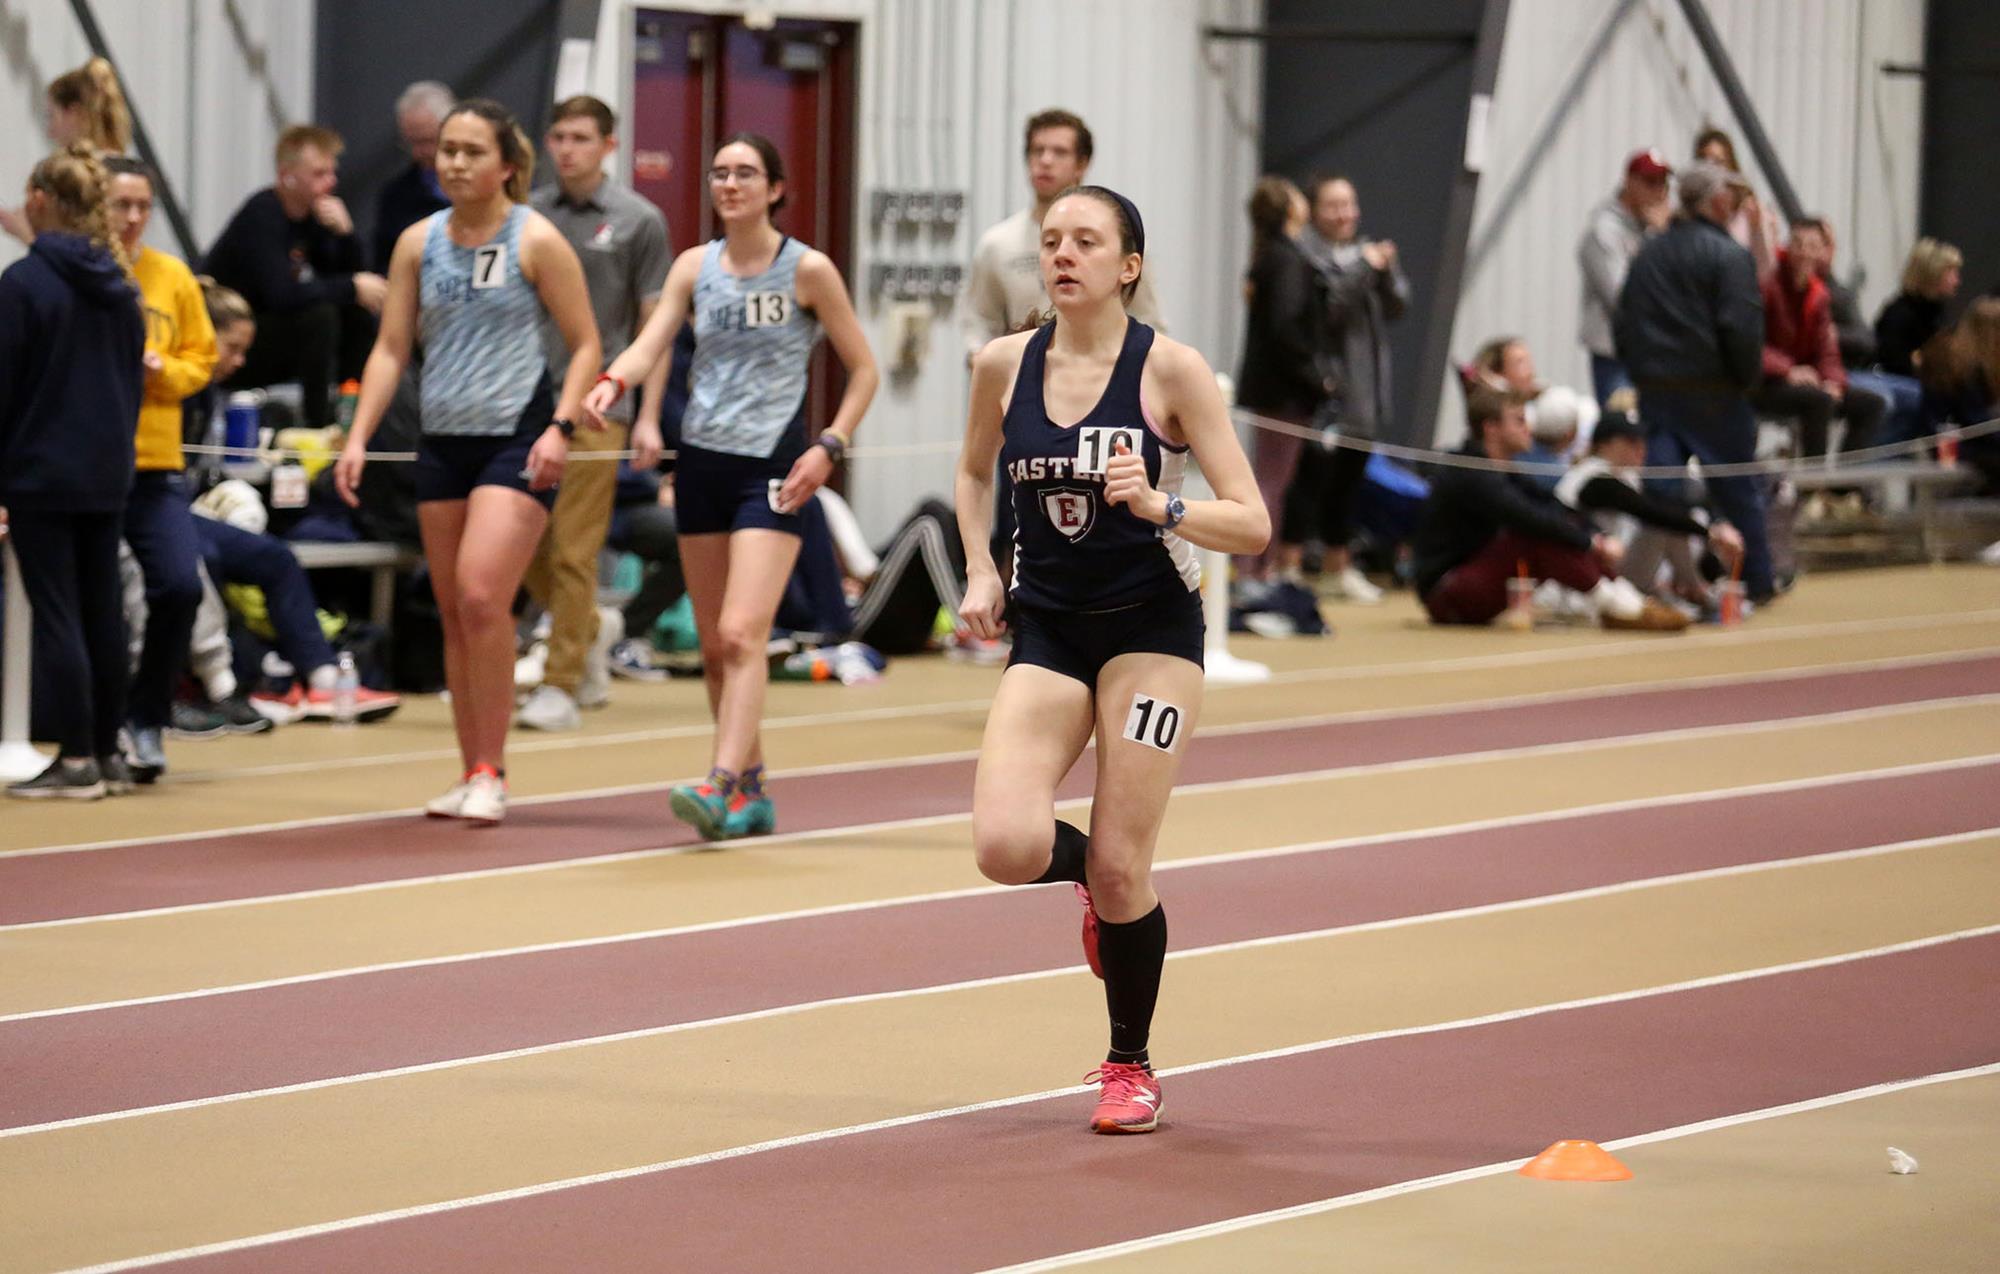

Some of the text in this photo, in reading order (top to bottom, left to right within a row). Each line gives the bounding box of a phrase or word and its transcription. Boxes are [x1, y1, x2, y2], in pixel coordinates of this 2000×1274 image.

[480, 249, 498, 282] 7
[751, 294, 784, 322] 13
[1057, 497, 1079, 527] E
[1134, 699, 1178, 749] 10
